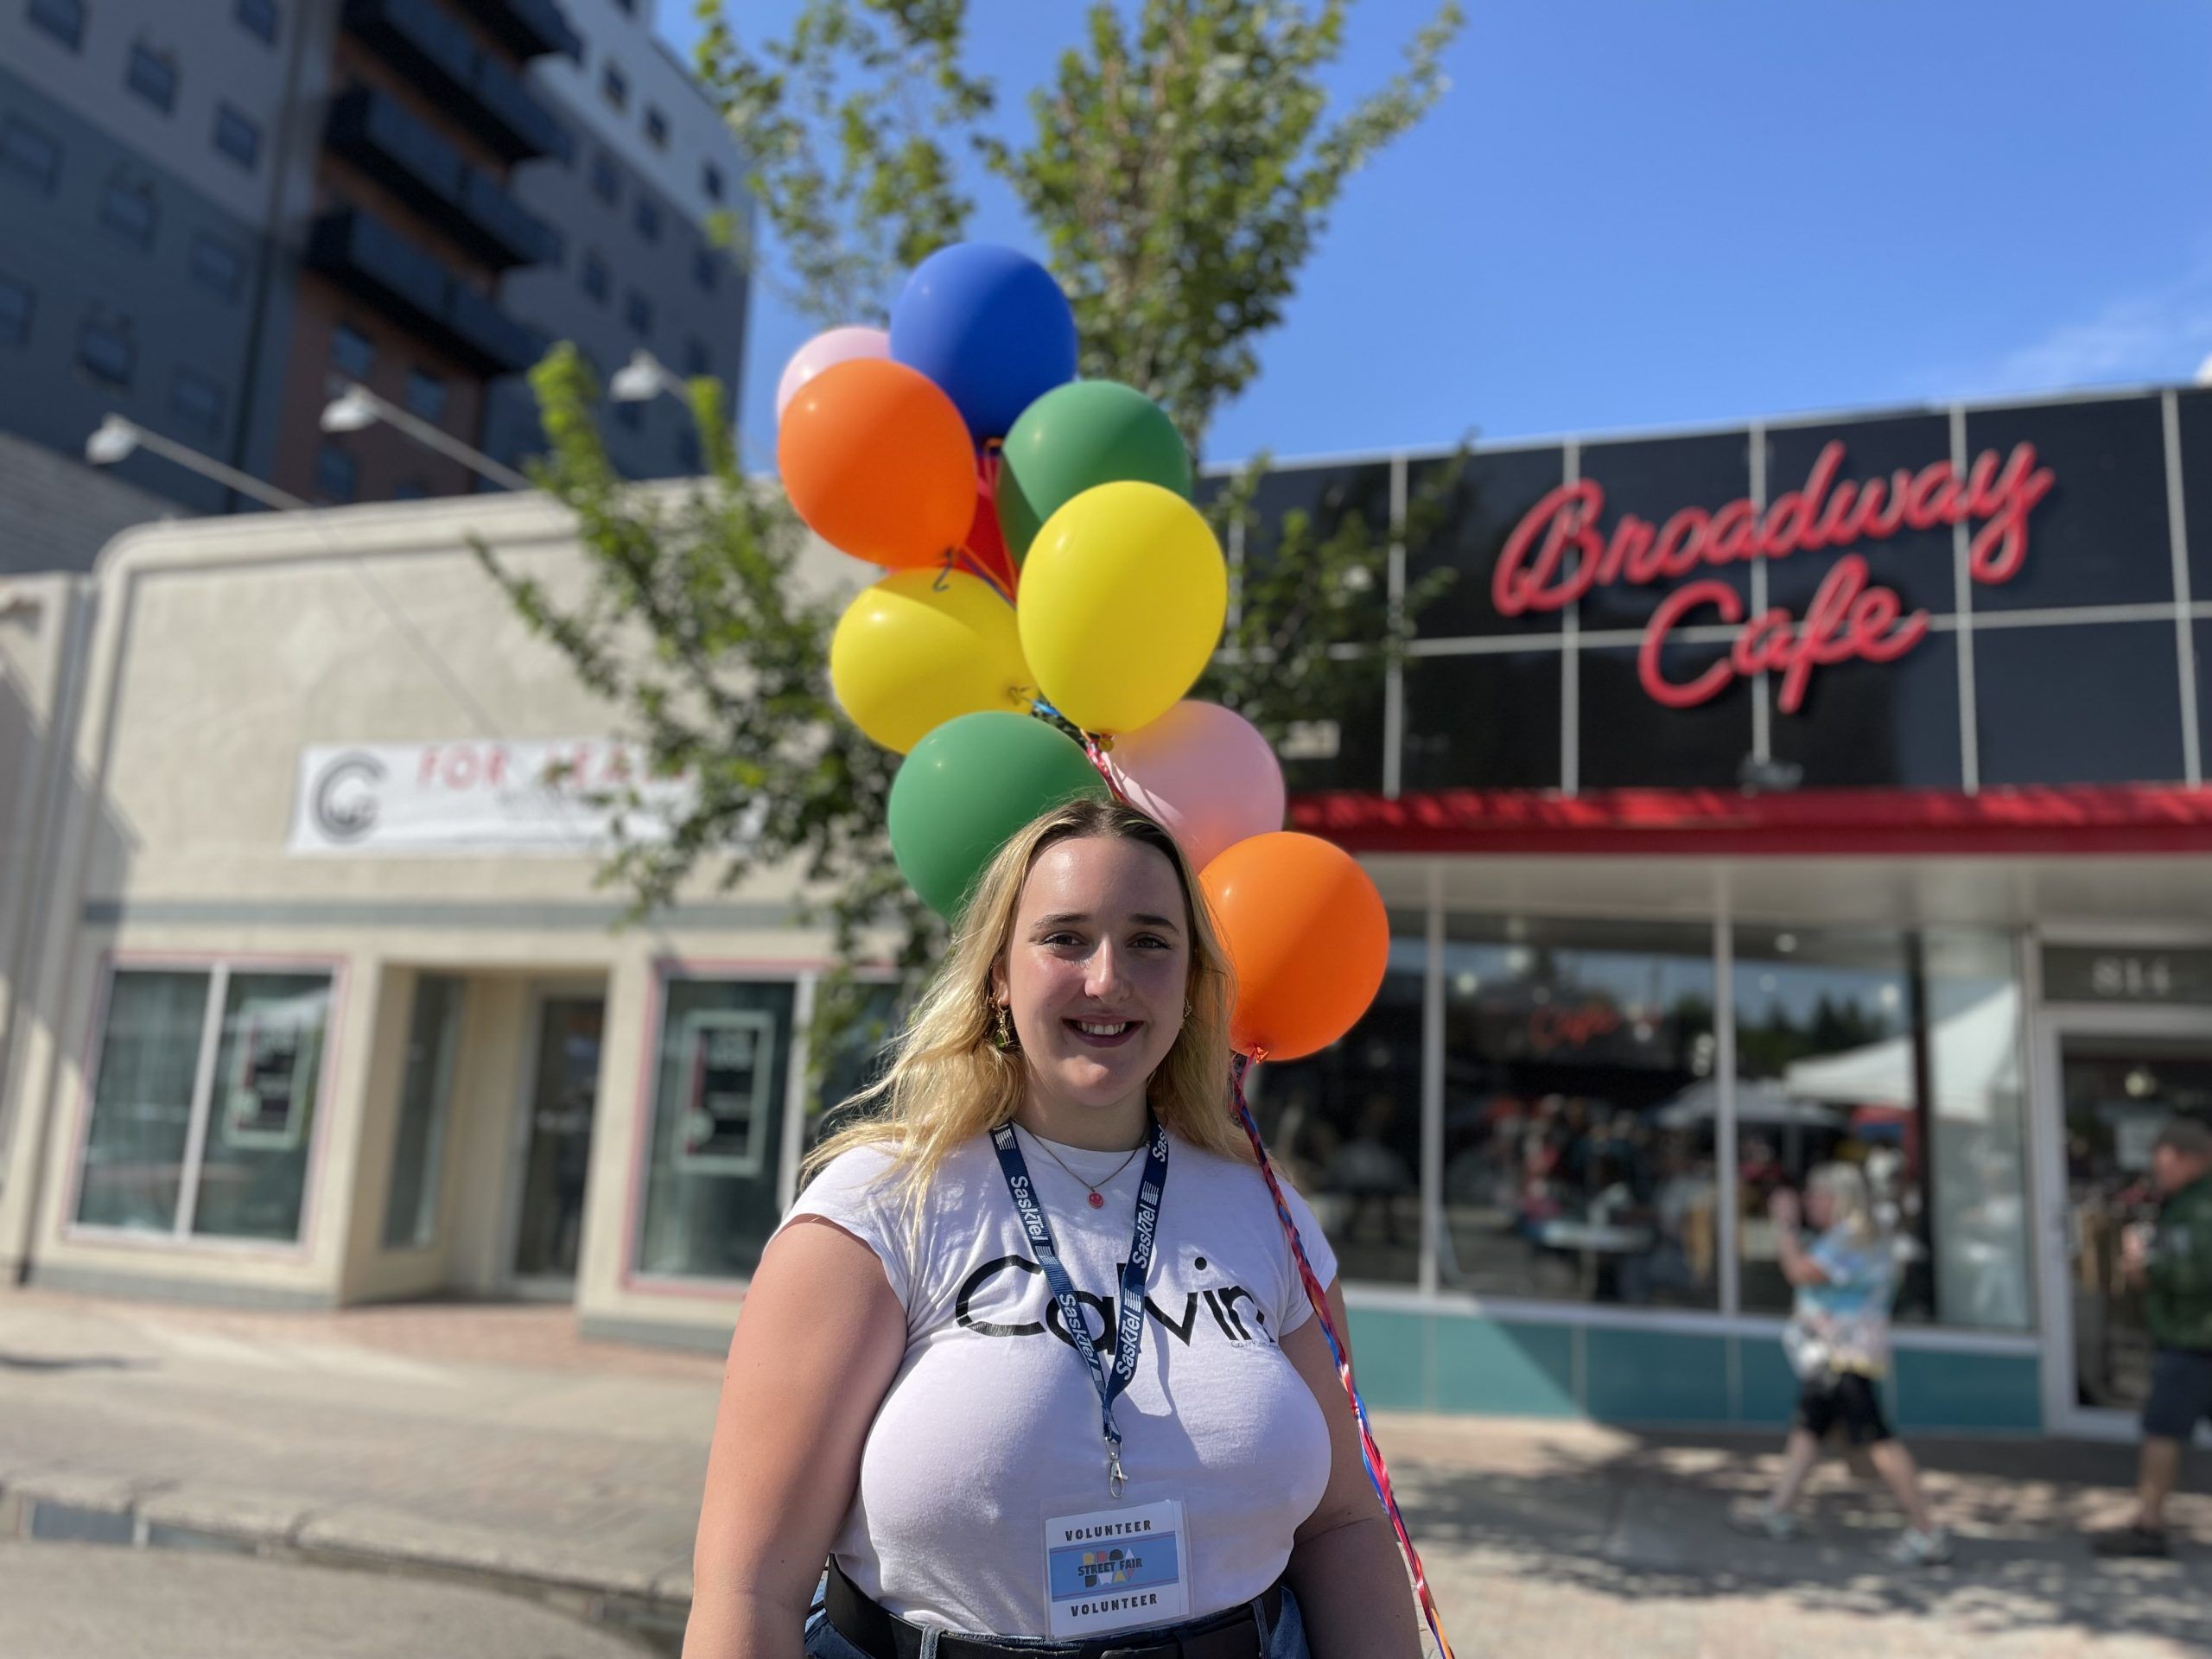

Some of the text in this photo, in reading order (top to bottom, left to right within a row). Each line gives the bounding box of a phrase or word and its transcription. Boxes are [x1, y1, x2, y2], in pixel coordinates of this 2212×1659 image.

[1491, 439, 2056, 616] Broadway
[1637, 552, 1930, 715] Cafe
[1010, 1175, 1049, 1241] SaskTel
[1132, 1203, 1156, 1269] SaskTel
[955, 1255, 1276, 1356] Cavin
[1058, 1294, 1099, 1365] SaskTel
[1116, 1309, 1141, 1381] SaskTel
[1065, 1520, 1152, 1541] VOLUNTEER
[1077, 1558, 1143, 1577] STREET FAIR
[1071, 1593, 1158, 1617] VOLUNTEER
